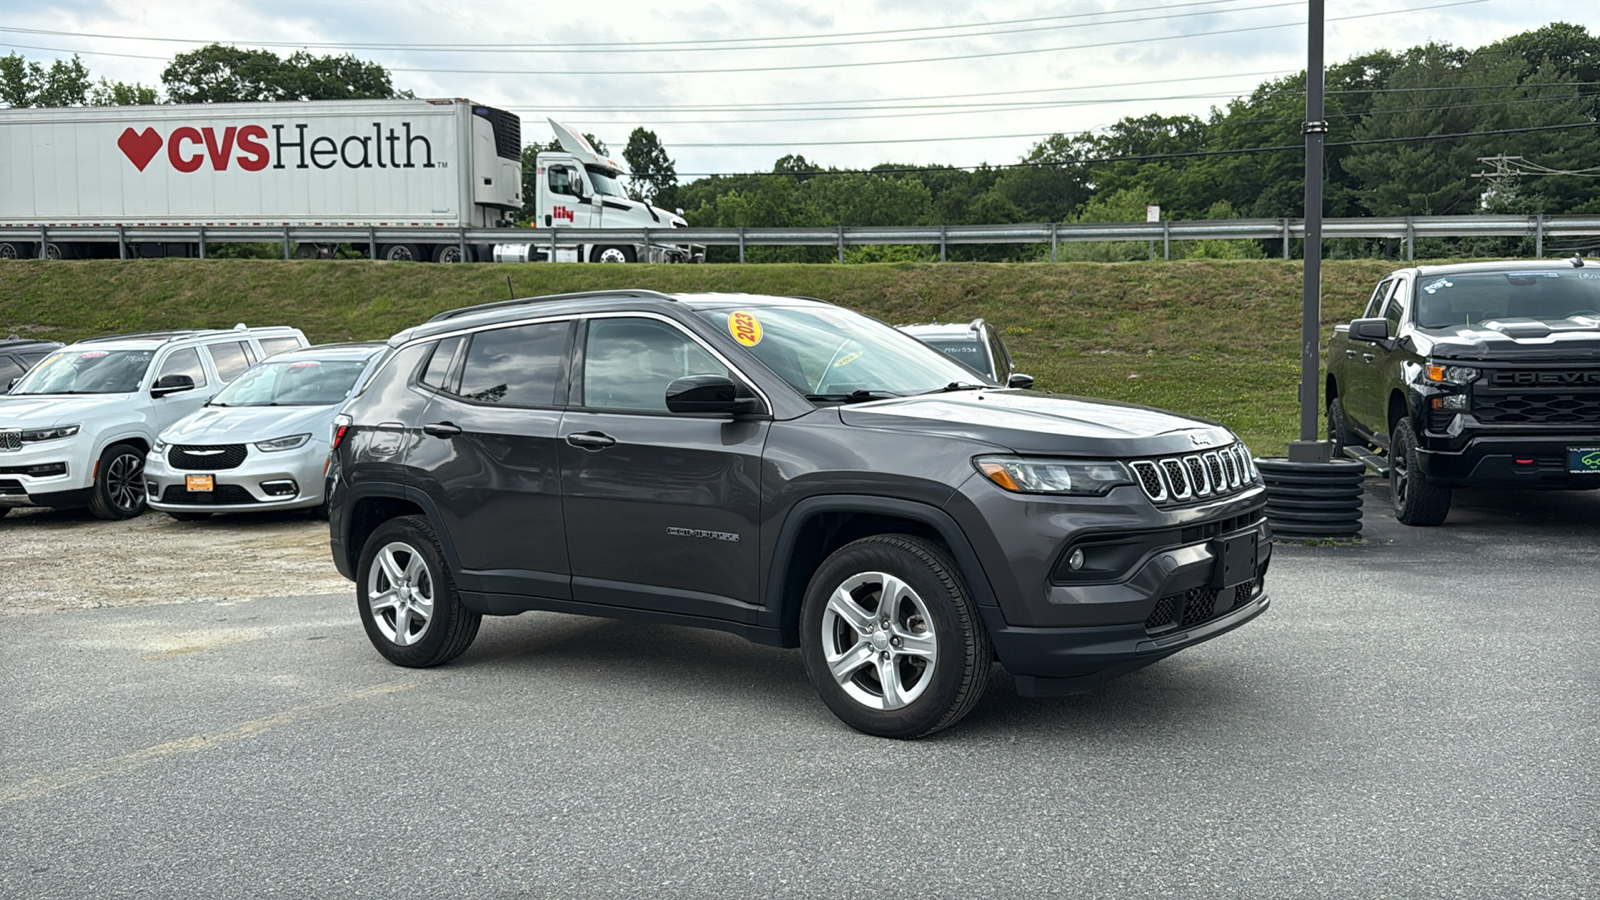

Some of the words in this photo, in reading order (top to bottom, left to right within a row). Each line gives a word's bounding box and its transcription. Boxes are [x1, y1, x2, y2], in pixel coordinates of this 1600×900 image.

[553, 205, 574, 223] lily
[734, 312, 755, 343] 2023
[666, 526, 740, 542] COMPASS
